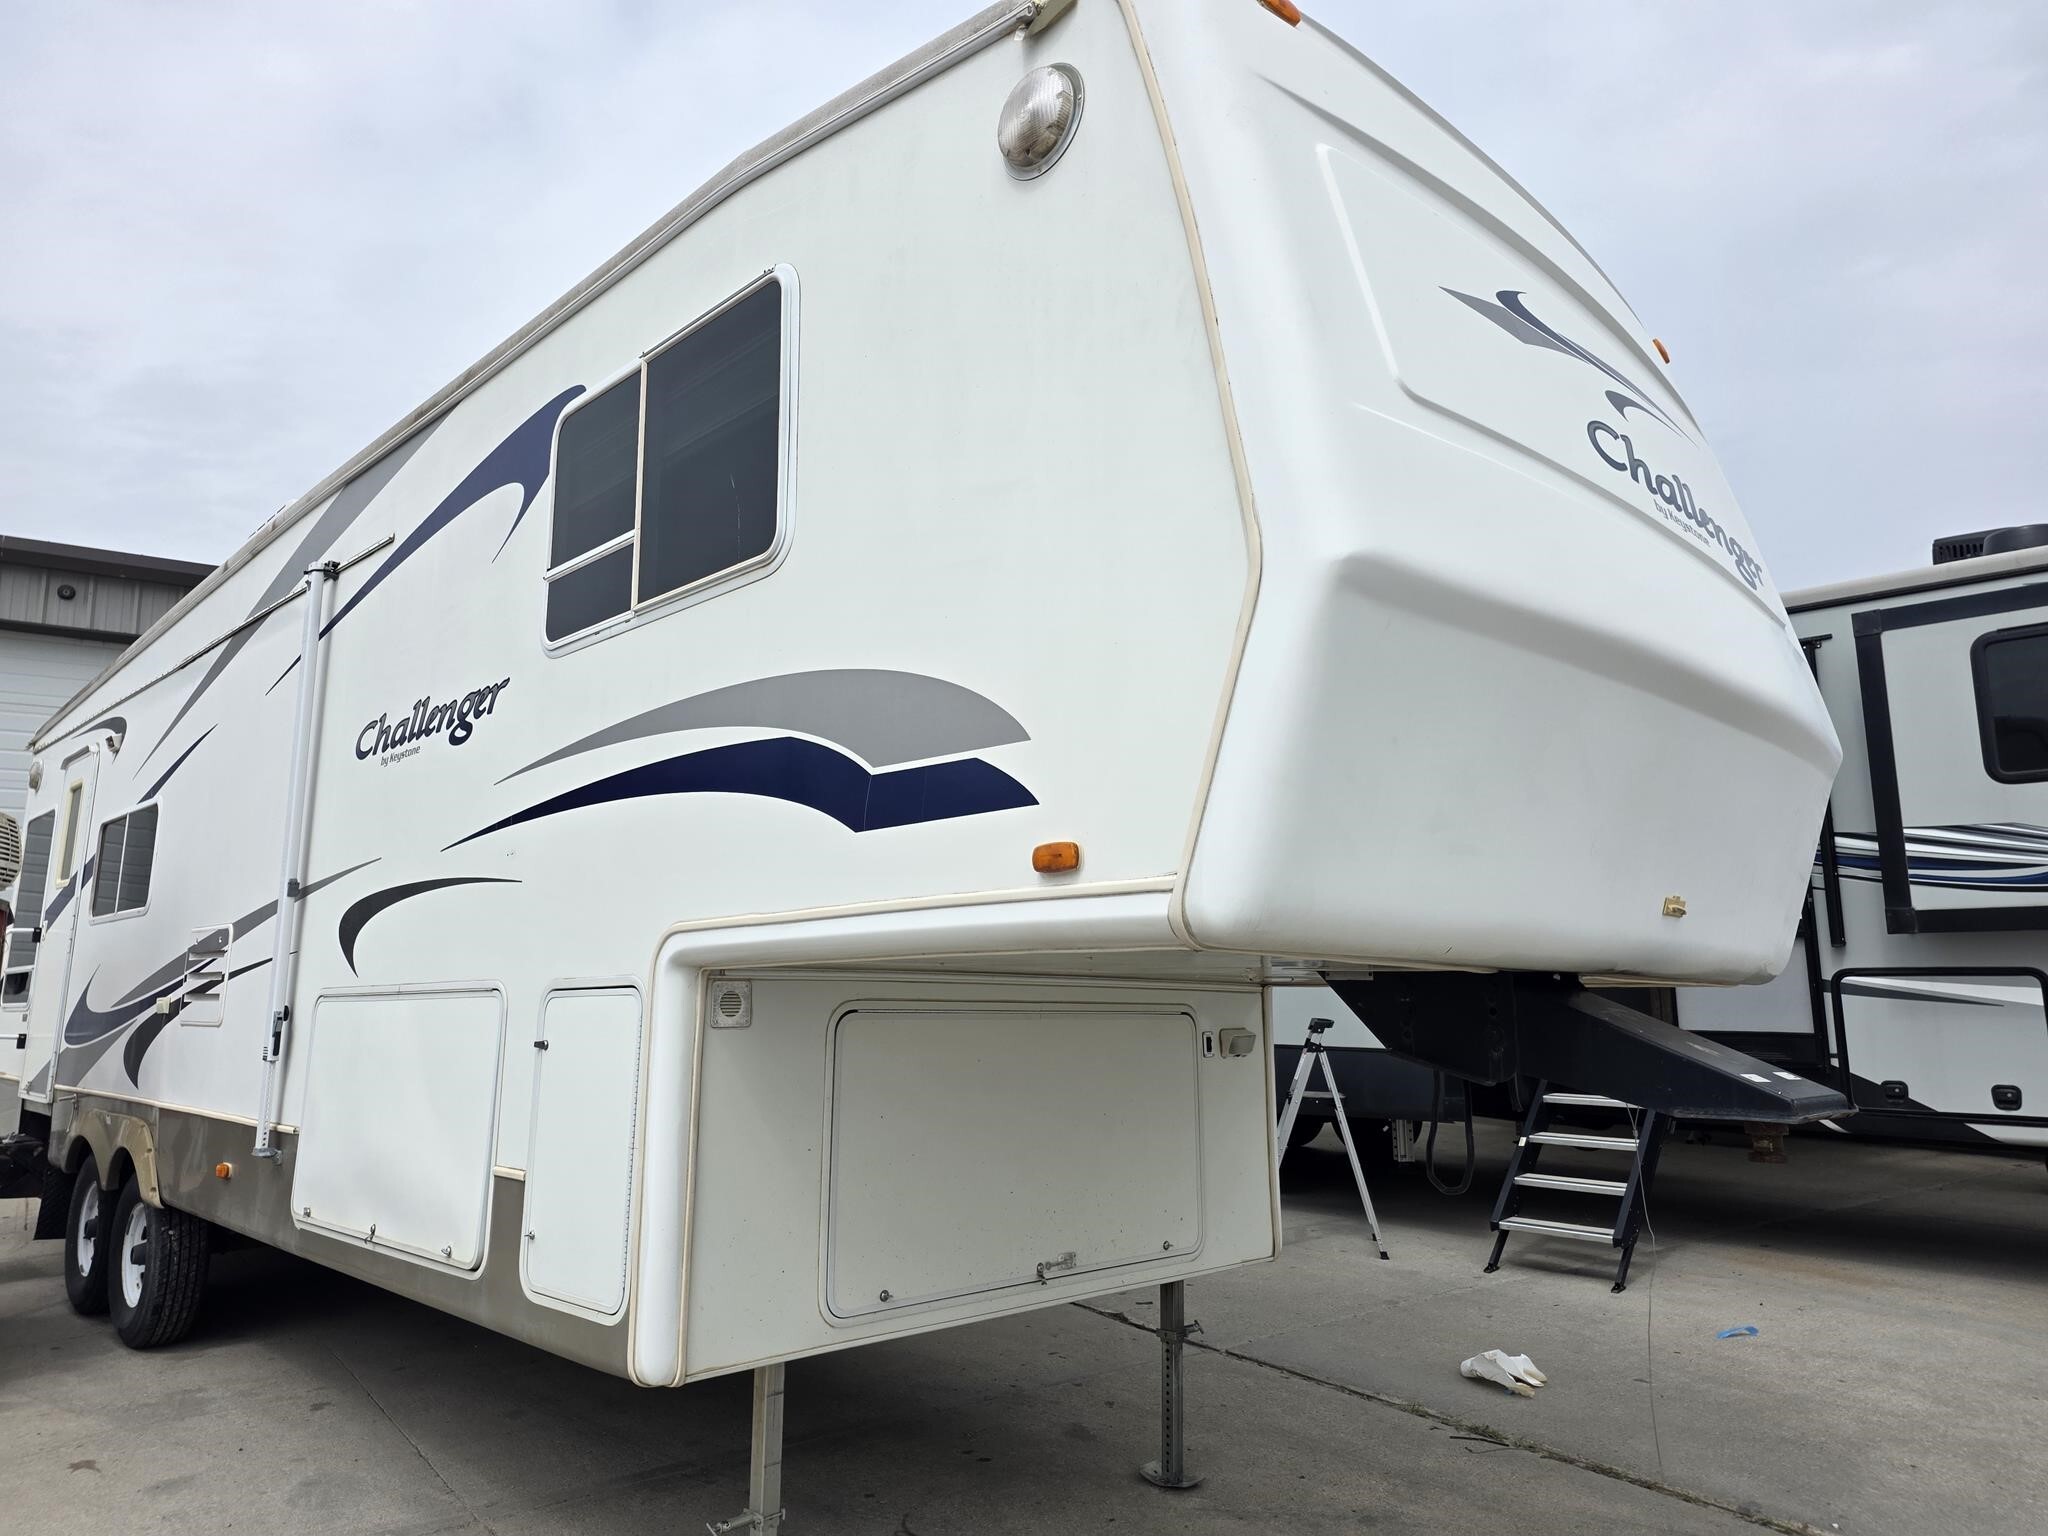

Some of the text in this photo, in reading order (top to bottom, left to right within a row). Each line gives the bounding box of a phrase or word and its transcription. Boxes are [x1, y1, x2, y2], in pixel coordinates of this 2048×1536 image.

[1587, 420, 1764, 590] Challenger
[1653, 499, 1669, 520] by
[355, 677, 511, 760] Challenger
[380, 746, 421, 767] by Keystone
